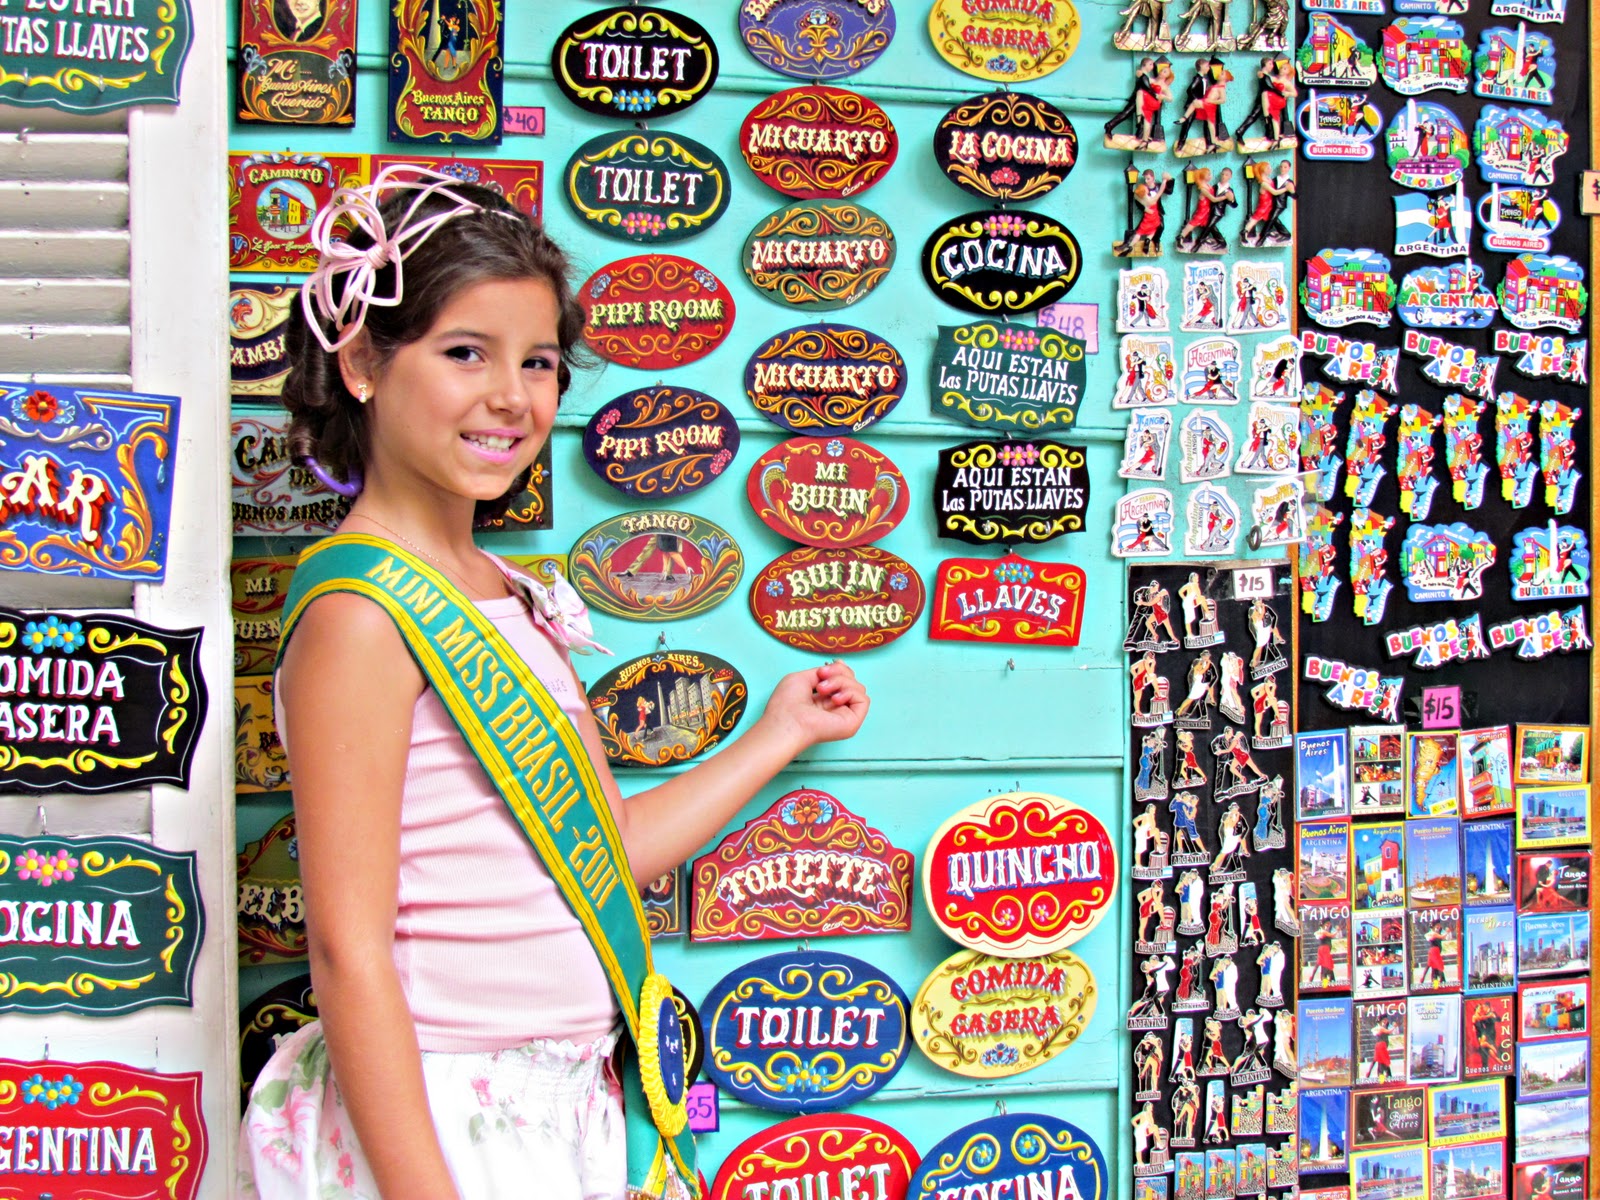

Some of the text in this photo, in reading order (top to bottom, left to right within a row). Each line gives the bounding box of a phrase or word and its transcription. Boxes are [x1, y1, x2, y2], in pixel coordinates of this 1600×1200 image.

[1400, 2, 1432, 10] CAMINITO
[1495, 6, 1562, 20] ARGENTINA
[56, 20, 149, 63] LLAVES
[961, 25, 1051, 56] CASERA
[265, 58, 298, 80] Mi
[582, 42, 691, 82] TOILET
[258, 76, 333, 96] Buenos Aires
[1481, 83, 1548, 101] BUENOS AIRES
[271, 93, 327, 117] Querido
[411, 90, 485, 106] Buenos Aires
[420, 105, 480, 124] TANGO
[1319, 115, 1342, 124] TANGO
[948, 131, 1070, 165] LA COCINA
[1344, 147, 1366, 155] AIRES
[248, 167, 324, 185] CAMINITO
[593, 166, 703, 206] TOILET
[1393, 170, 1462, 188] BUENOS AIRES
[1487, 172, 1518, 181] CAMINITO
[1500, 208, 1522, 217] TANGO
[1398, 243, 1467, 255] ARGENTINA
[1492, 238, 1543, 249] BUENOS AIRES
[941, 238, 1067, 279] COCINA
[1407, 292, 1498, 309] ARGENTINA
[590, 297, 722, 331] PIPI ROOM
[230, 334, 286, 366] AMB
[1303, 333, 1376, 362] BUENOS
[1406, 332, 1477, 367] BUENOS
[1497, 332, 1565, 355] BUENOS
[951, 346, 1069, 381] AQUI ESTAN
[939, 366, 1079, 406] Las PUTAS LLAVES
[596, 424, 725, 461] PIPI ROOM
[815, 461, 848, 482] MI
[952, 466, 1071, 489] AQUI ESTAN
[290, 495, 351, 523] AIRES
[788, 482, 870, 518] BULIN
[942, 487, 1084, 512] Las PUTAS LLAVES
[623, 514, 693, 534] TANGO
[245, 577, 274, 596] MI
[786, 560, 886, 598] BULIN
[1414, 590, 1446, 600] CAMINITO
[1519, 584, 1584, 597] BUENOS AIRES
[956, 585, 1066, 622] LLAVES
[775, 602, 903, 629] MISTONGO
[1389, 621, 1458, 653] BUENOS
[1491, 612, 1562, 646] BUENOS
[619, 653, 700, 682] BUENOS AIRES
[1308, 659, 1379, 689] BUENOS
[365, 555, 448, 627] MINI
[434, 615, 514, 713] MISS
[489, 693, 582, 834] BRASIL
[1424, 693, 1455, 721] $15
[1300, 739, 1330, 758] Buenos Aires
[1301, 824, 1348, 839] Buenos Aires
[1468, 823, 1506, 832] ARGENTINA
[1304, 838, 1342, 846] ARGENTINA
[723, 853, 884, 904] TOILETTE
[949, 841, 1102, 900] QUINCHO
[1557, 865, 1587, 882] Tango
[1371, 895, 1403, 908] Caminito
[1299, 906, 1350, 921] TANGO
[1409, 907, 1460, 924] TANGO
[950, 961, 1066, 1001] COMIDA
[1471, 981, 1513, 990] ARGENTINA
[1356, 1002, 1407, 1018] TANGO
[732, 1006, 886, 1048] TOILET
[950, 1005, 1064, 1040] CASERA
[1129, 1018, 1167, 1029] ARGENTINA
[1234, 1070, 1270, 1086] ARGENTINA
[1465, 1063, 1512, 1075] Buenos Aires
[1304, 1088, 1343, 1097] ARGENTINA
[1385, 1094, 1422, 1111] Tango
[1389, 1120, 1419, 1130] Aires
[1390, 1111, 1419, 1121] Buenos
[1553, 1170, 1582, 1186] Tango
